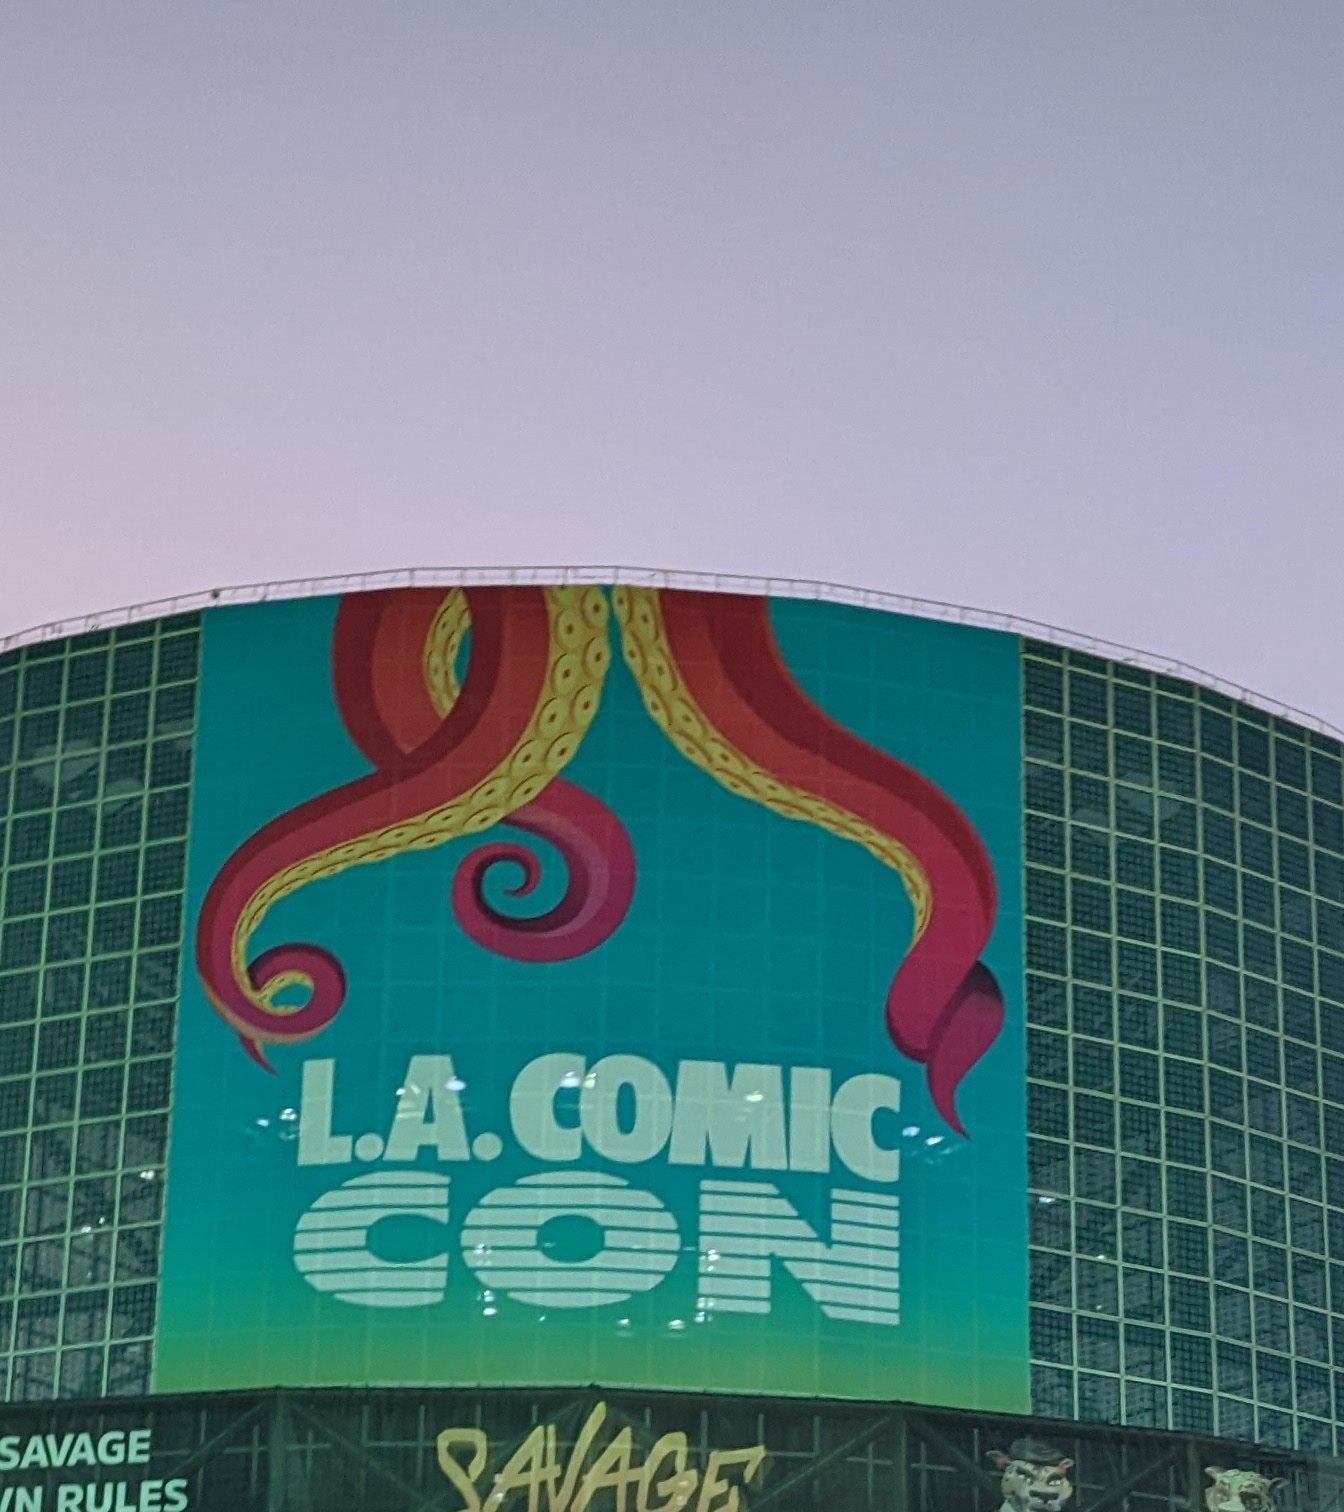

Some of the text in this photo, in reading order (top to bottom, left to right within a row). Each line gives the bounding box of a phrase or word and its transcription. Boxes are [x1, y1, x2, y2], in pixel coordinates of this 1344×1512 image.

[297, 1053, 901, 1182] L.A. COMIC
[294, 1171, 900, 1325] CON
